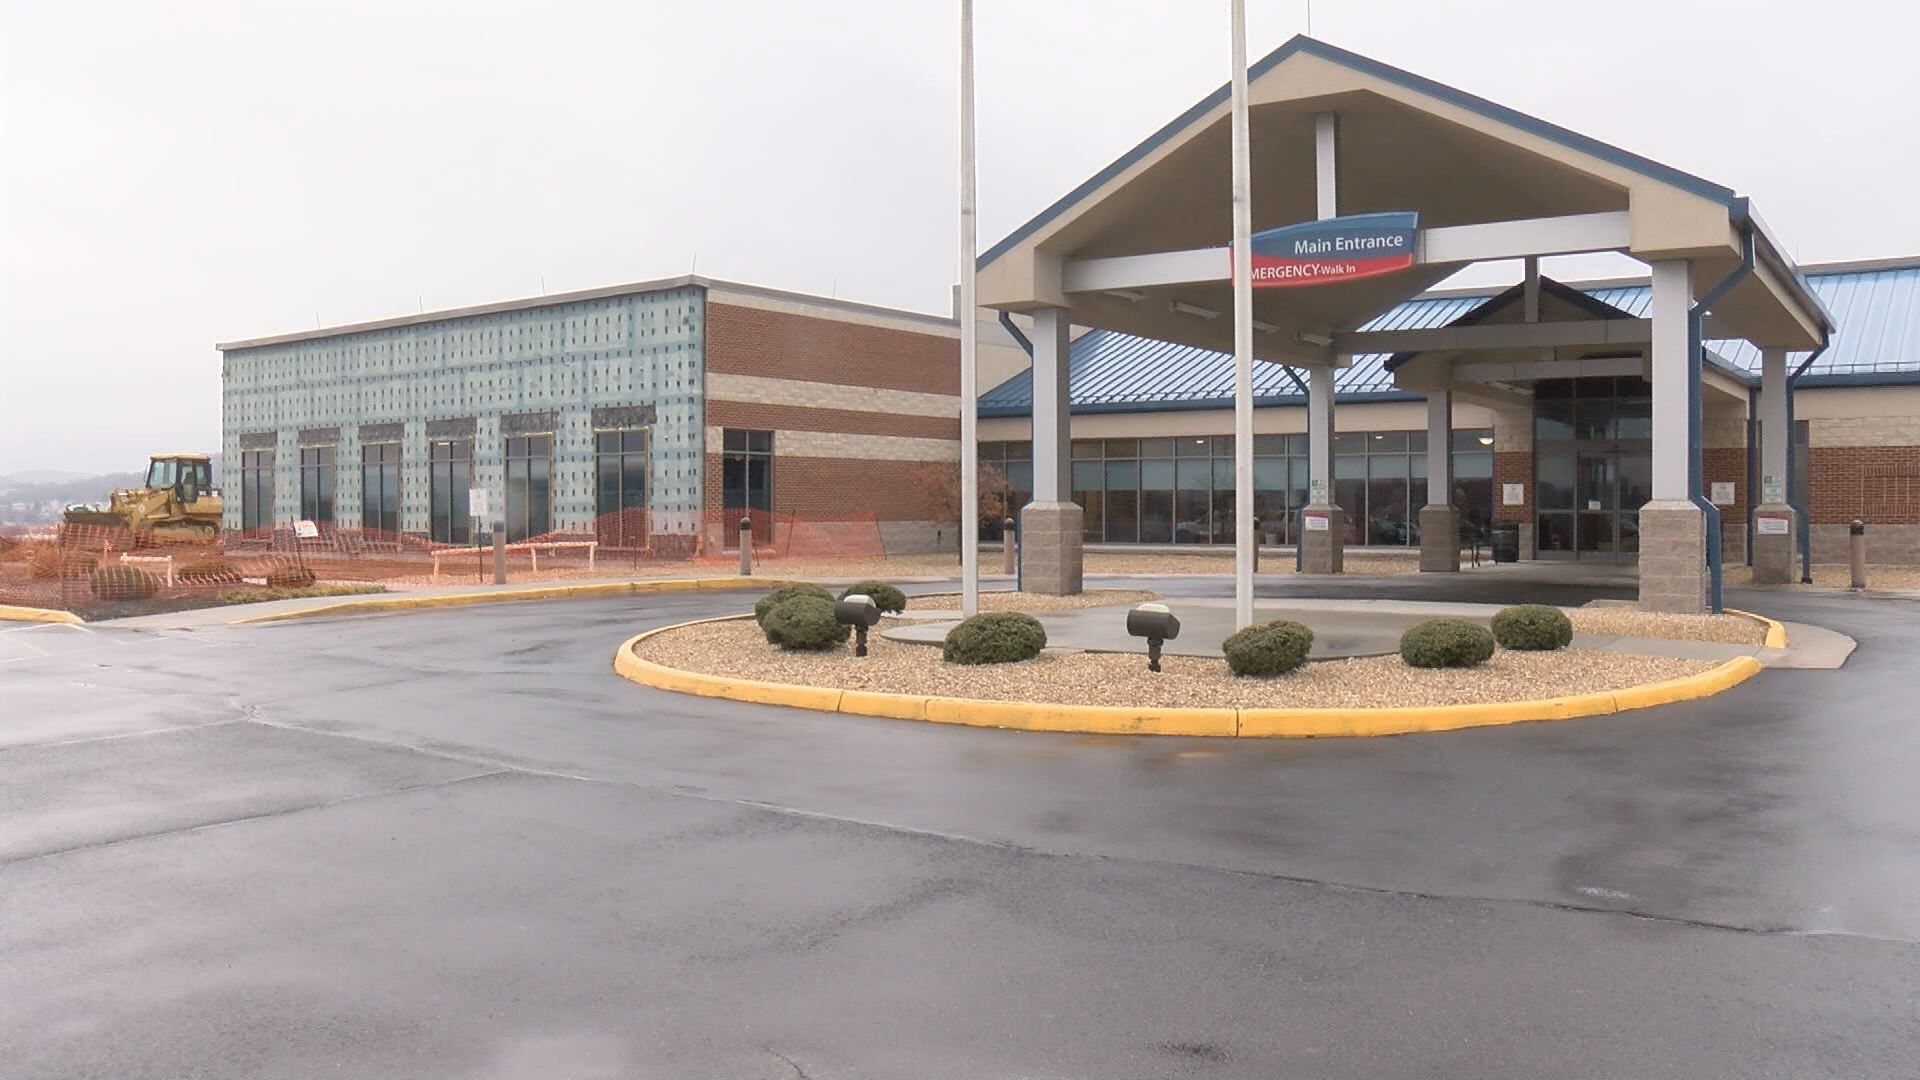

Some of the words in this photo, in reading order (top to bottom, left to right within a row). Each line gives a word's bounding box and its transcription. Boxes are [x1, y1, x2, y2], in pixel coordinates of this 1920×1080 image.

[1294, 239, 1332, 255] Main
[1335, 235, 1404, 251] Entrance
[1346, 264, 1356, 273] In
